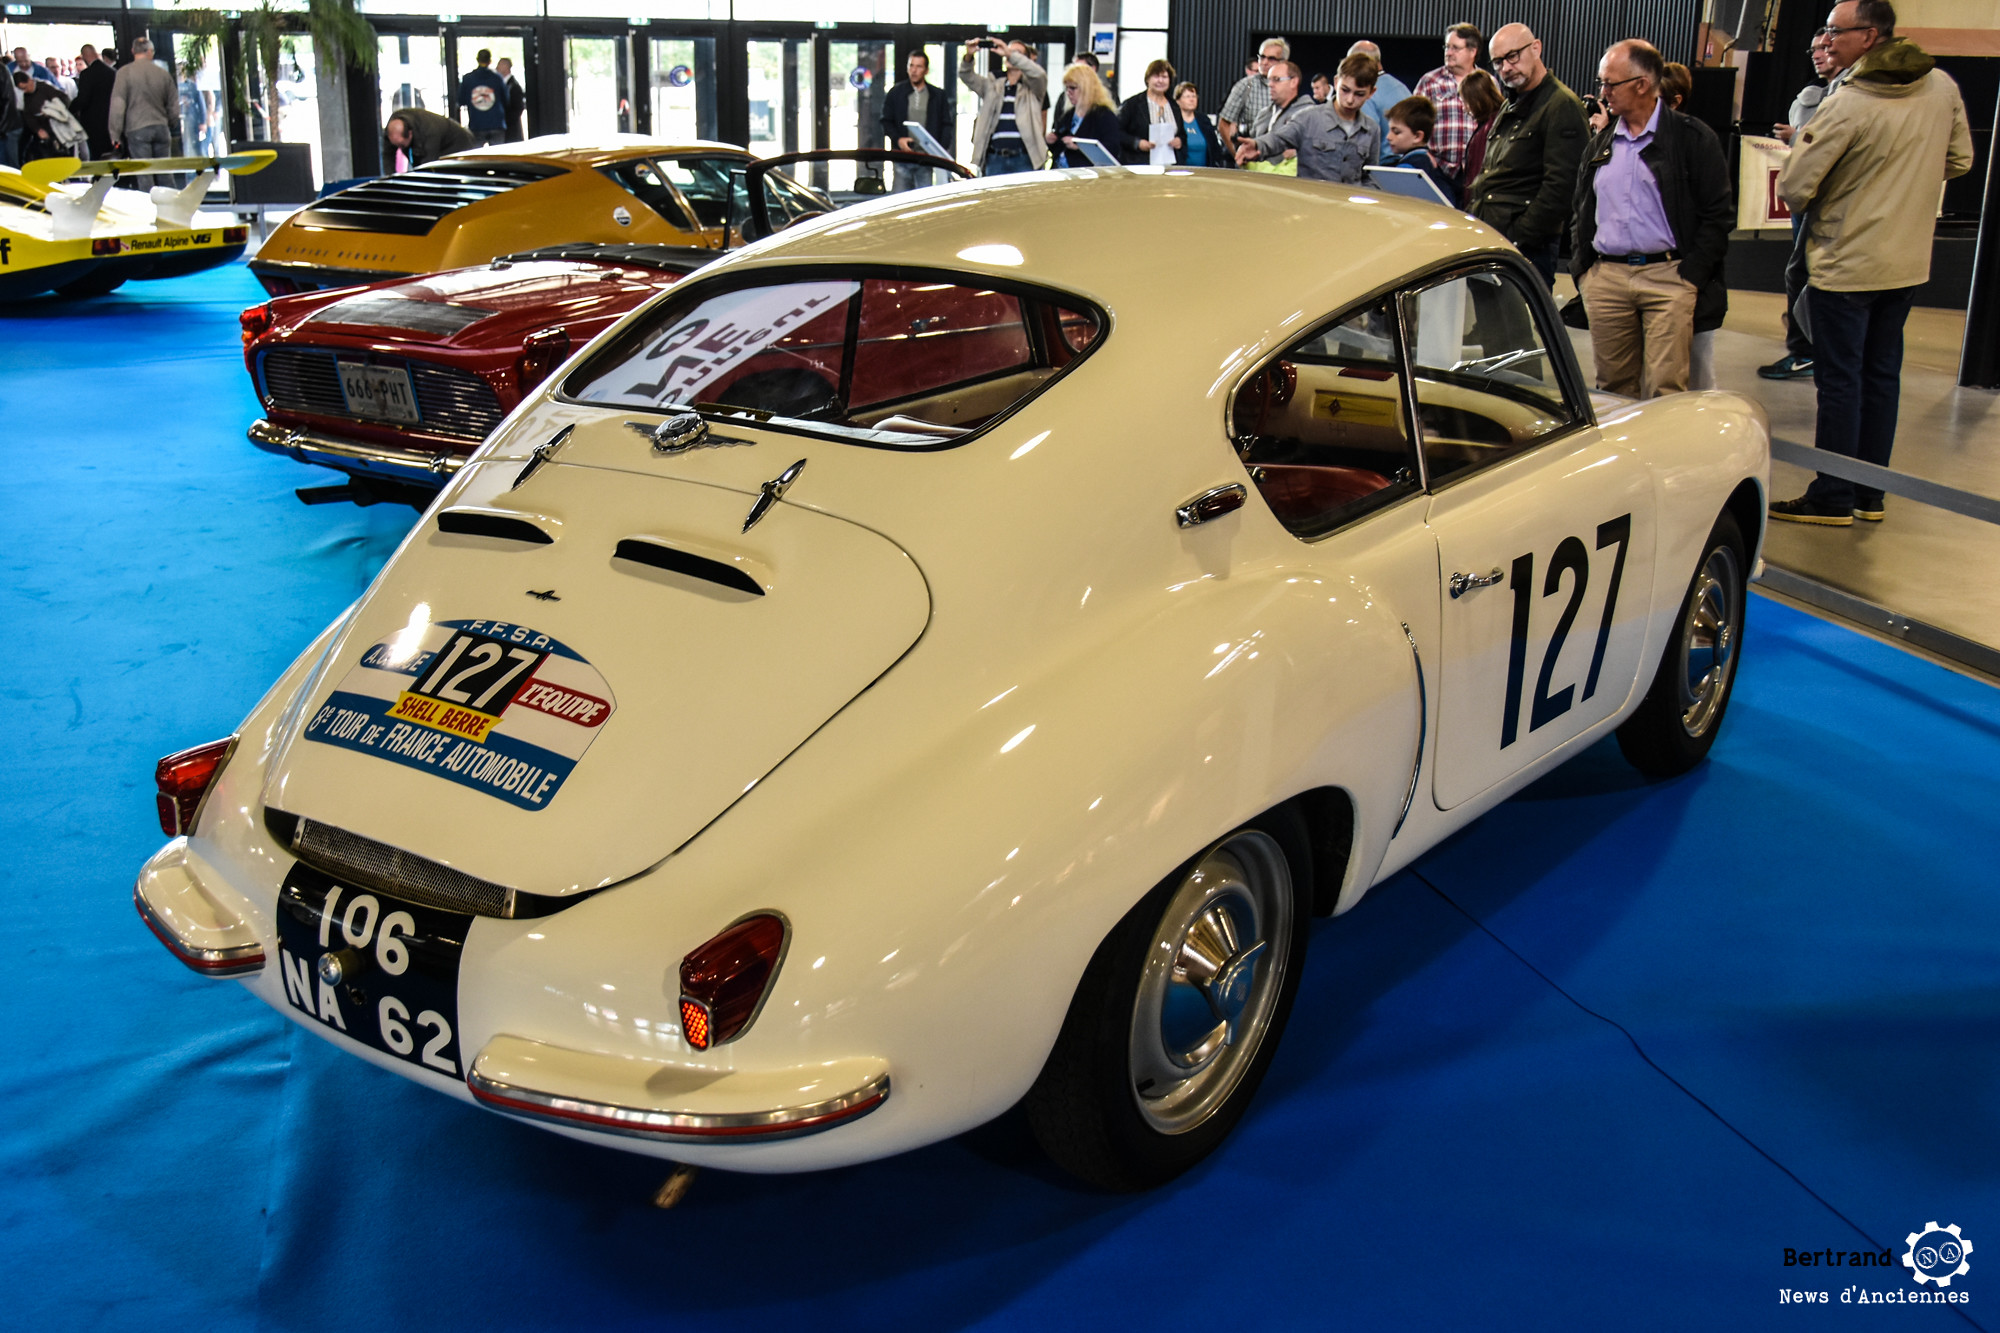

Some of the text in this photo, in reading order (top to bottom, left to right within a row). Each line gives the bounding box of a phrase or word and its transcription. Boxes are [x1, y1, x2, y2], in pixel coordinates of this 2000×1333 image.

[131, 233, 212, 250] Renault Alpine V6
[419, 635, 539, 709] 127
[1499, 512, 1632, 751] 127
[324, 709, 370, 742] TOUR
[359, 724, 386, 746] DE
[379, 723, 452, 765] FRANCE
[439, 741, 558, 804] AUTOMOBILE
[395, 696, 490, 737] SHELL BERRE
[319, 885, 416, 976] 106
[282, 948, 457, 1075] NA 62
